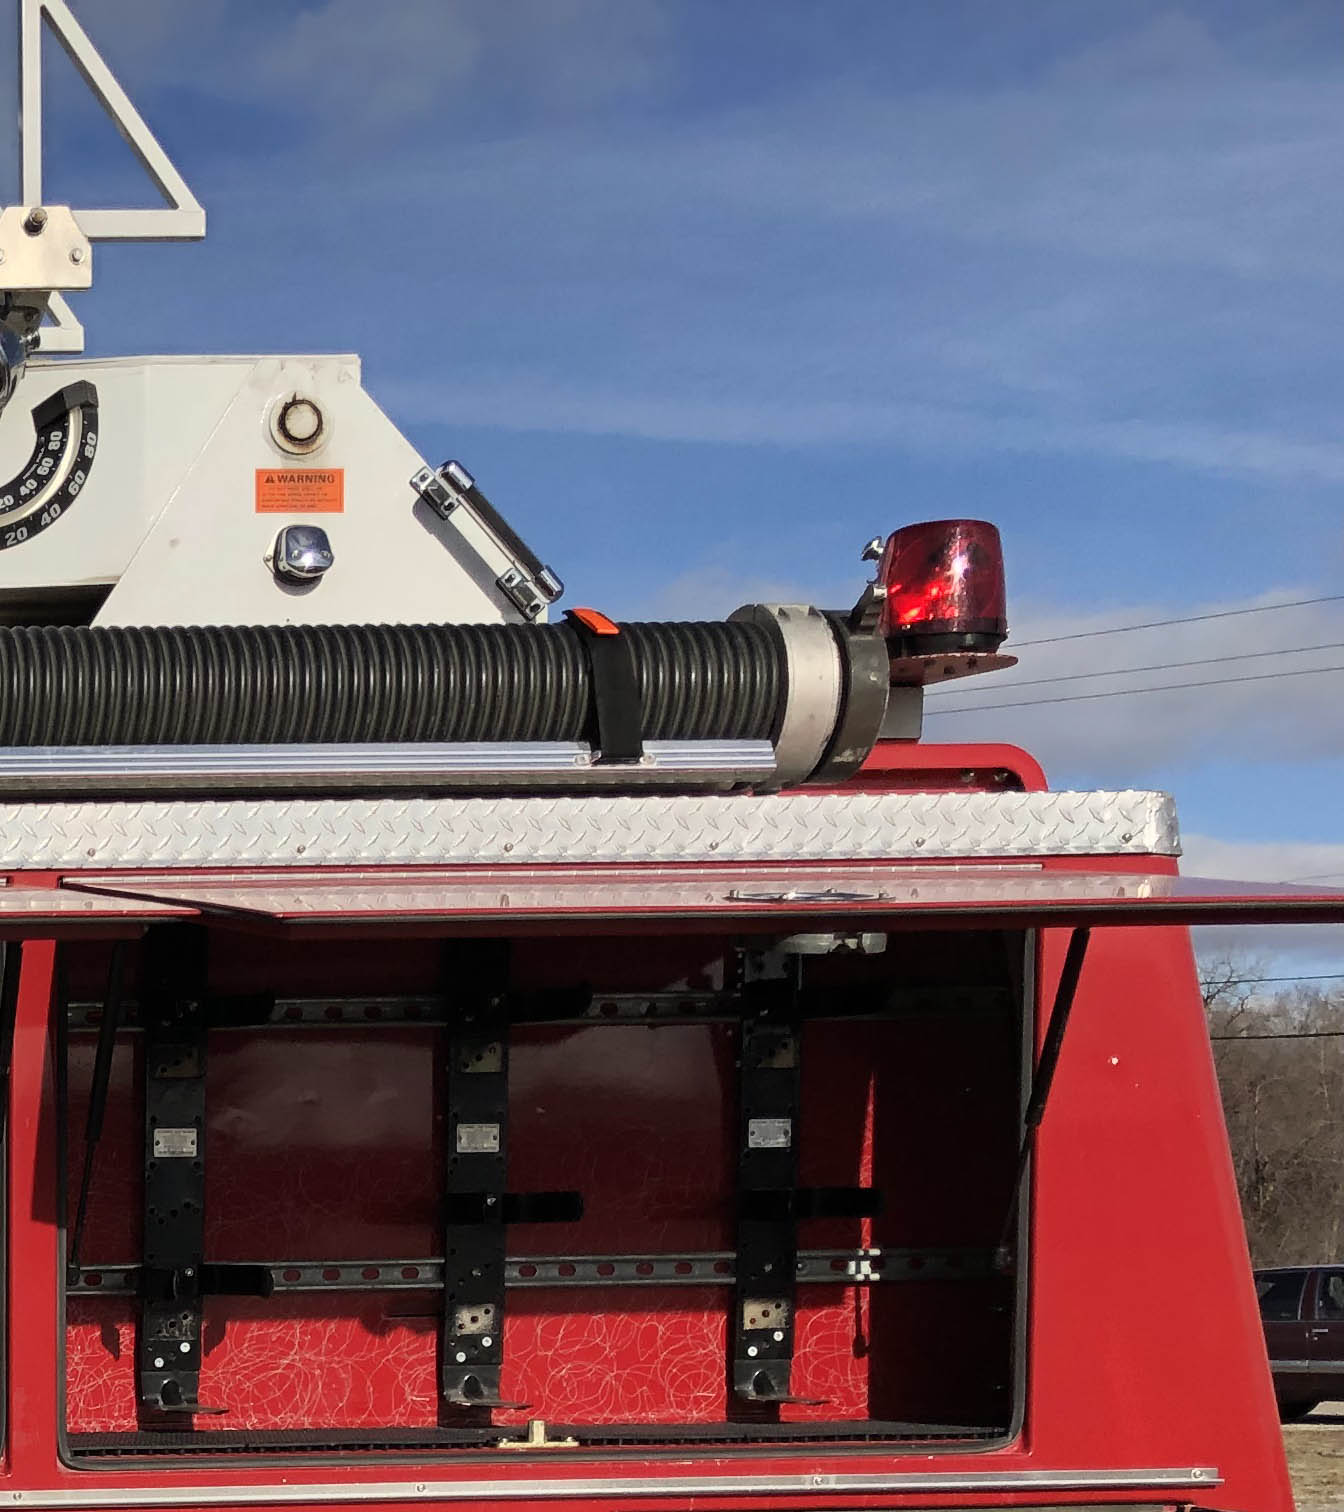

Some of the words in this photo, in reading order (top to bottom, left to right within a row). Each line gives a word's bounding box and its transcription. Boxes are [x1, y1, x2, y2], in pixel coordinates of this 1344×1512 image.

[48, 431, 63, 450] 80
[84, 432, 97, 458] 80
[36, 457, 54, 475] 60
[19, 479, 38, 496] 40
[68, 470, 85, 496] 60
[277, 474, 335, 484] WARNING
[40, 503, 61, 526] 40
[5, 527, 28, 546] 20
